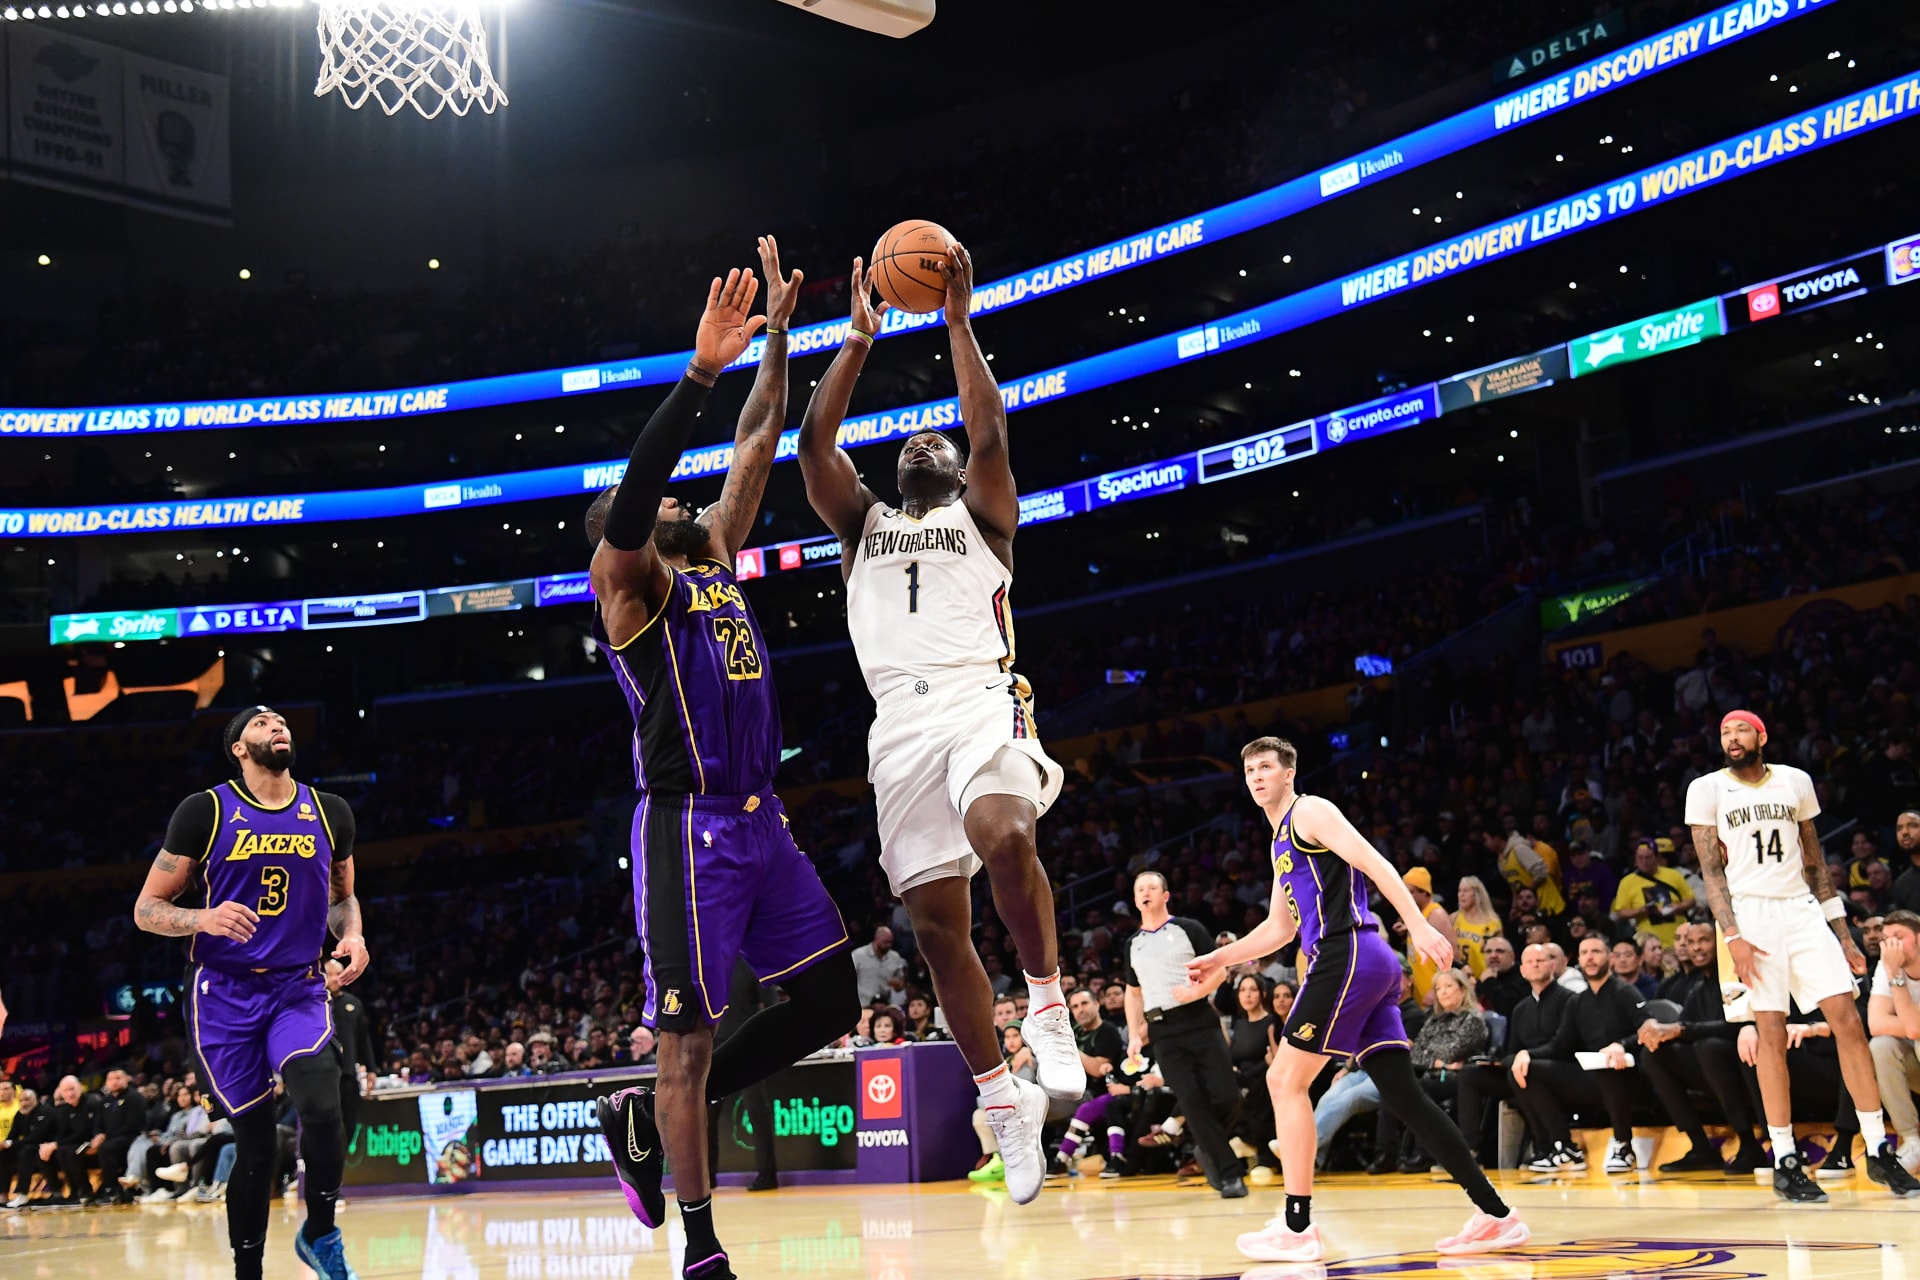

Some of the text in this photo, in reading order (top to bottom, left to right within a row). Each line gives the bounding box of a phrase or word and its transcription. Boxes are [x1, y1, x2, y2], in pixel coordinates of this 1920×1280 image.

[1531, 23, 1607, 67] DELTA
[1494, 0, 1789, 130] WHERE DISCOVERY LEADS
[1360, 149, 1404, 178] Health
[1341, 260, 1410, 306] WHERE
[1412, 218, 1528, 282] DISCOVERY
[1530, 193, 1602, 242] LEADS
[1606, 181, 1637, 214] TO
[1641, 116, 1818, 202] WORLD-CLASS
[1086, 235, 1154, 277] HEALTH
[1155, 218, 1205, 255] CARE
[1782, 267, 1860, 303] TOYOTA
[1220, 318, 1262, 344] Health
[1637, 310, 1706, 351] Sprite
[601, 366, 642, 384] Health
[1020, 371, 1067, 405] CARE
[0, 388, 449, 433] COVERY LEADS TO WORLD-CLASS HEALTH CARE
[1348, 397, 1425, 433] crypto.com
[1231, 434, 1287, 470] 9:02
[462, 483, 503, 501] Health
[1097, 463, 1183, 502] Spectrum
[0, 498, 306, 534] TO WORLD-CLASS HEALTH CARE
[802, 541, 843, 561] TOYOT
[862, 527, 967, 563] NEW ORLEANS
[904, 560, 921, 615] 1
[108, 612, 168, 640] Sprite
[214, 607, 297, 630] DELTA
[712, 616, 763, 681] 23
[1561, 646, 1596, 669] 101
[1725, 803, 1798, 830] NEW ORLEAN
[225, 829, 317, 861] LAKERS
[1751, 828, 1785, 864] 14
[257, 866, 290, 917] 3
[501, 1104, 540, 1133] THE
[772, 1096, 855, 1147] bibigo
[366, 1123, 422, 1166] bibigo
[482, 1137, 539, 1168] GAME
[540, 1134, 582, 1165] DAY
[855, 1128, 910, 1148] TOYOTA
